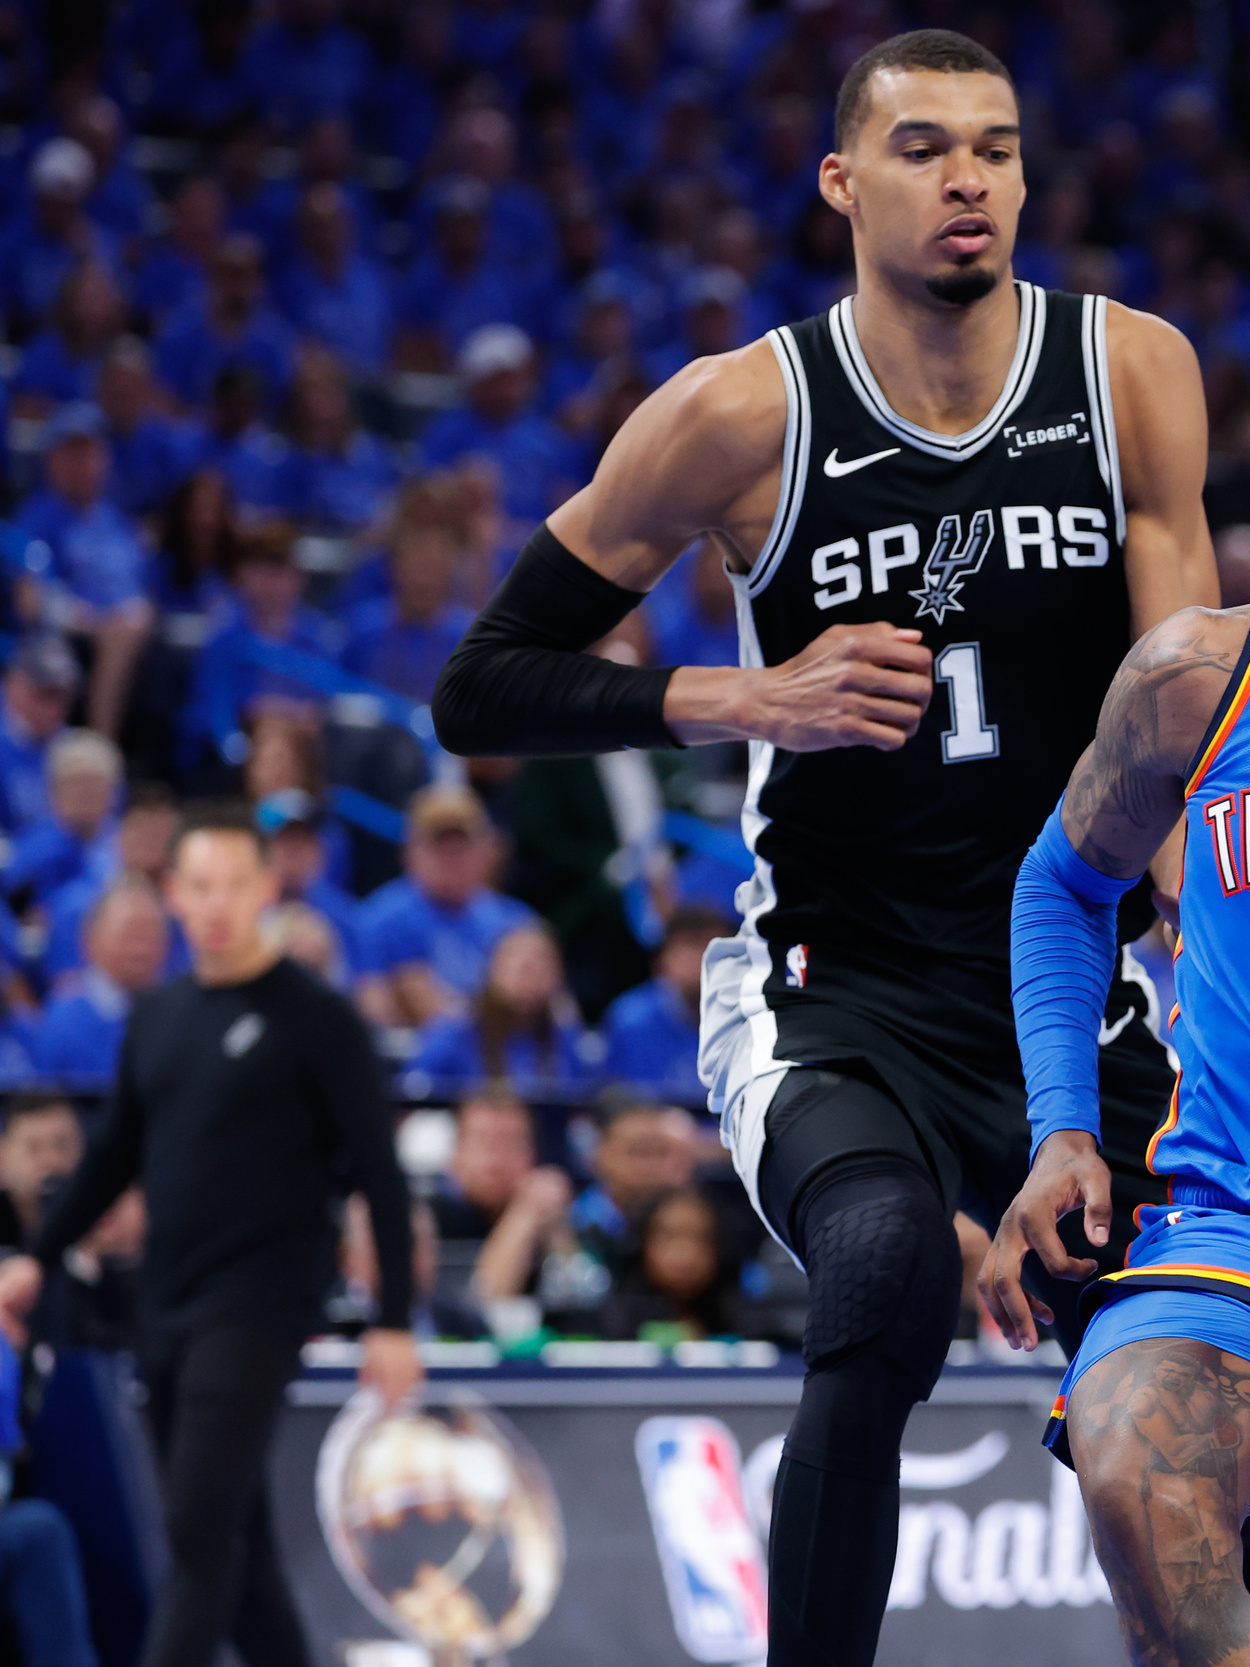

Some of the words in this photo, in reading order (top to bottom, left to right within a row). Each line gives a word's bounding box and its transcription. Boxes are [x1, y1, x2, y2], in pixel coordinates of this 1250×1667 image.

[1015, 422, 1078, 448] LEDGER
[811, 505, 1110, 625] SPURS
[934, 641, 1000, 764] 1
